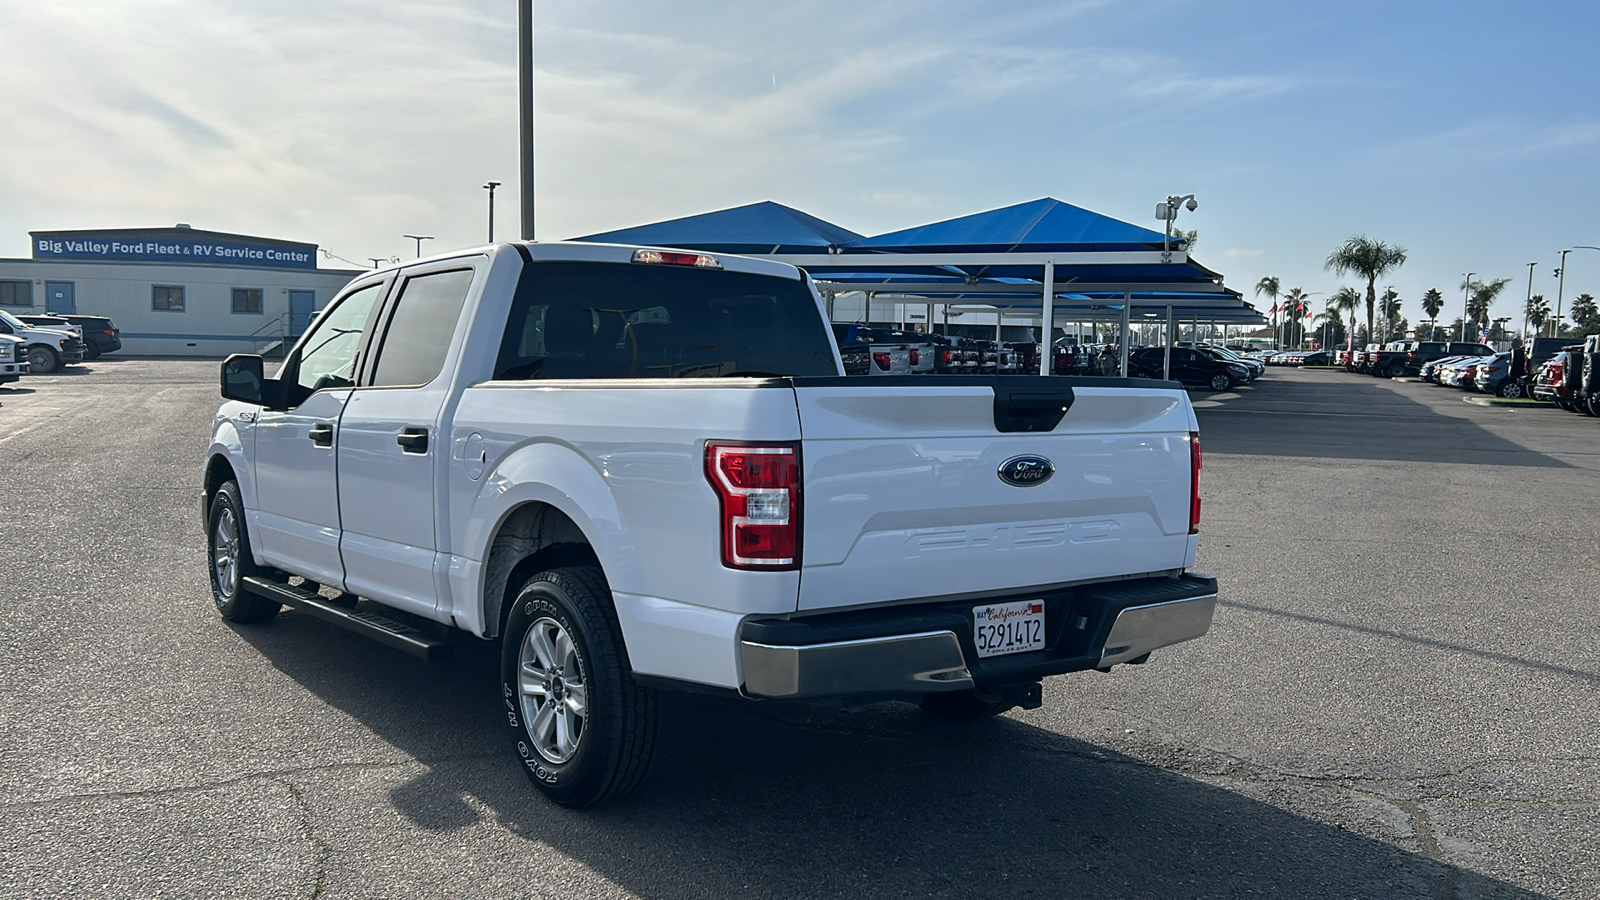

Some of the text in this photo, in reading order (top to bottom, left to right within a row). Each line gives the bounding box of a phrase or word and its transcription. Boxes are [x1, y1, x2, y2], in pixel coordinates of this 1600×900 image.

[38, 240, 309, 262] Big Valley Ford Fleet & RV Service Center
[1013, 461, 1045, 480] Ford
[524, 599, 557, 617] OPEN
[976, 611, 987, 619] MAY
[987, 606, 1033, 622] California
[978, 619, 1041, 650] 52914T2
[518, 741, 558, 783] TOYO
